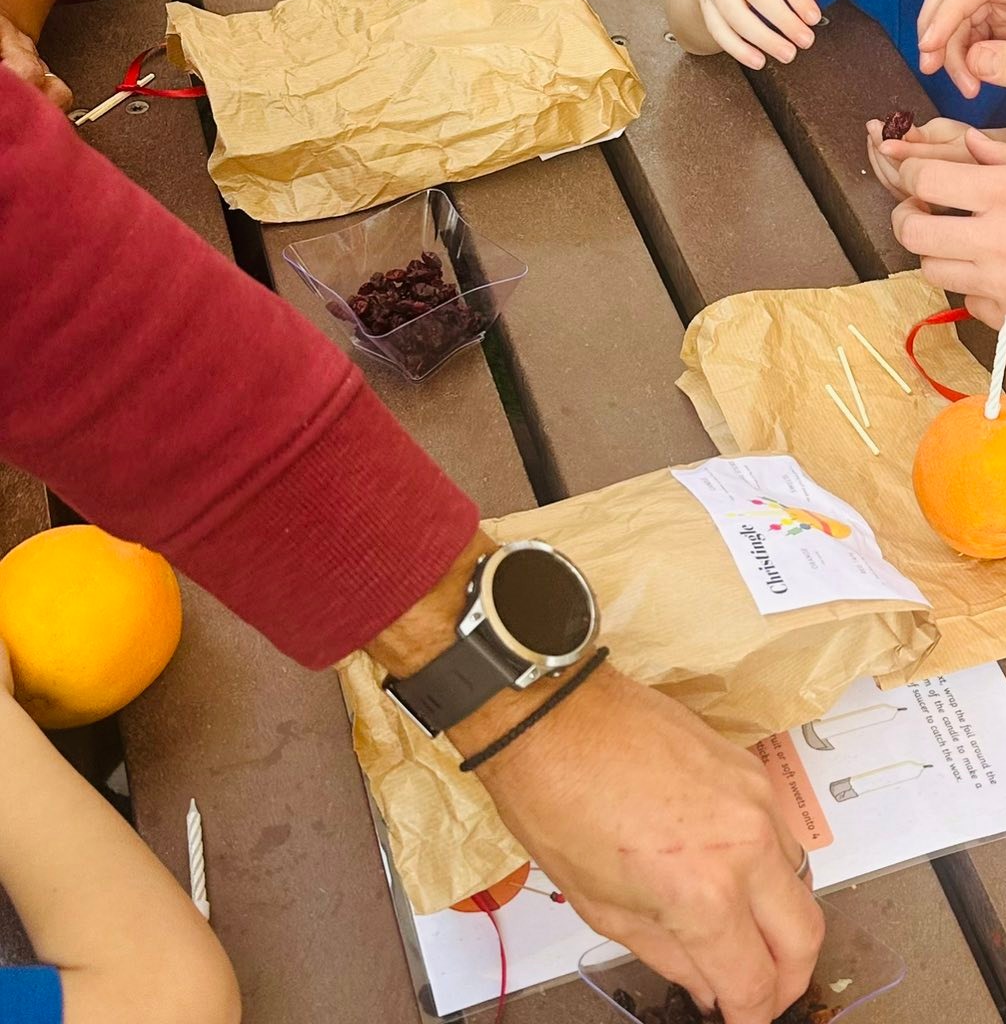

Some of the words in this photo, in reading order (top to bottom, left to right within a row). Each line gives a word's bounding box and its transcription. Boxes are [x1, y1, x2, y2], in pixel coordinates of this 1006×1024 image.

[739, 524, 788, 594] Christingle
[912, 689, 930, 714] saucer
[926, 715, 934, 724] to
[930, 725, 946, 747] catch
[942, 748, 953, 762] the
[949, 763, 962, 783] wax.
[928, 689, 940, 697] of
[934, 700, 945, 713] the
[942, 716, 960, 742] candle
[956, 745, 965, 754] to
[963, 757, 978, 780] make
[943, 687, 958, 708] wrap
[955, 709, 965, 723] the
[960, 724, 975, 738] foil
[970, 740, 991, 769] around
[986, 771, 997, 785] the
[770, 733, 782, 750] ruit
[776, 751, 786, 761] or
[781, 763, 796, 779] soft
[789, 781, 806, 809] sweets
[802, 810, 815, 831] onto
[812, 832, 820, 840] 4
